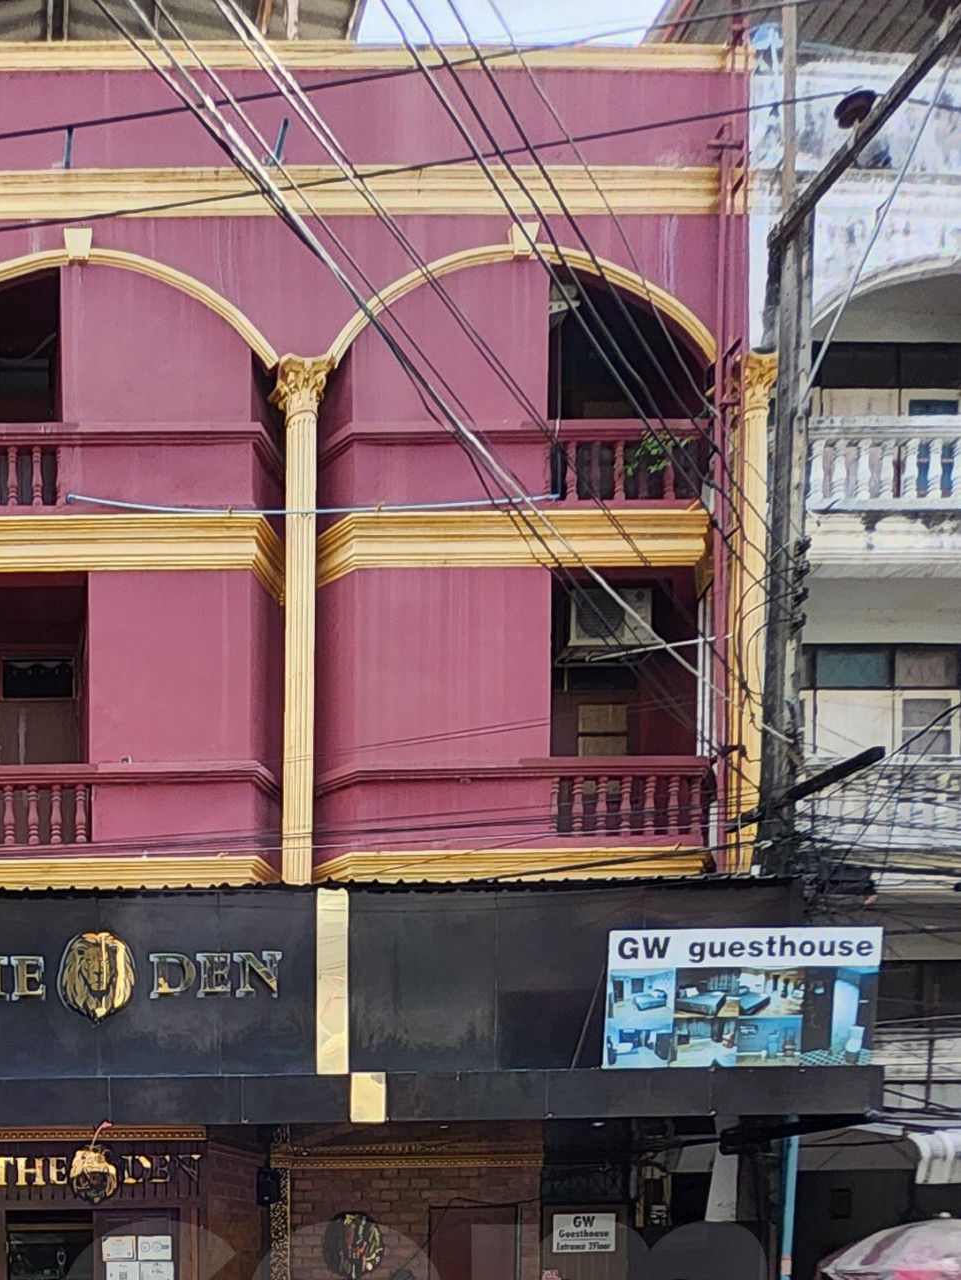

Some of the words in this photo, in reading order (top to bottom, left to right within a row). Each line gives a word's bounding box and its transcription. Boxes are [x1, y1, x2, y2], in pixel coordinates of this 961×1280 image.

[617, 936, 671, 960] GW
[688, 935, 873, 963] guesthouse
[148, 950, 283, 999] DEN
[122, 1153, 203, 1185] DEN
[558, 1229, 610, 1238] Guesthouse
[572, 1215, 596, 1228] GW
